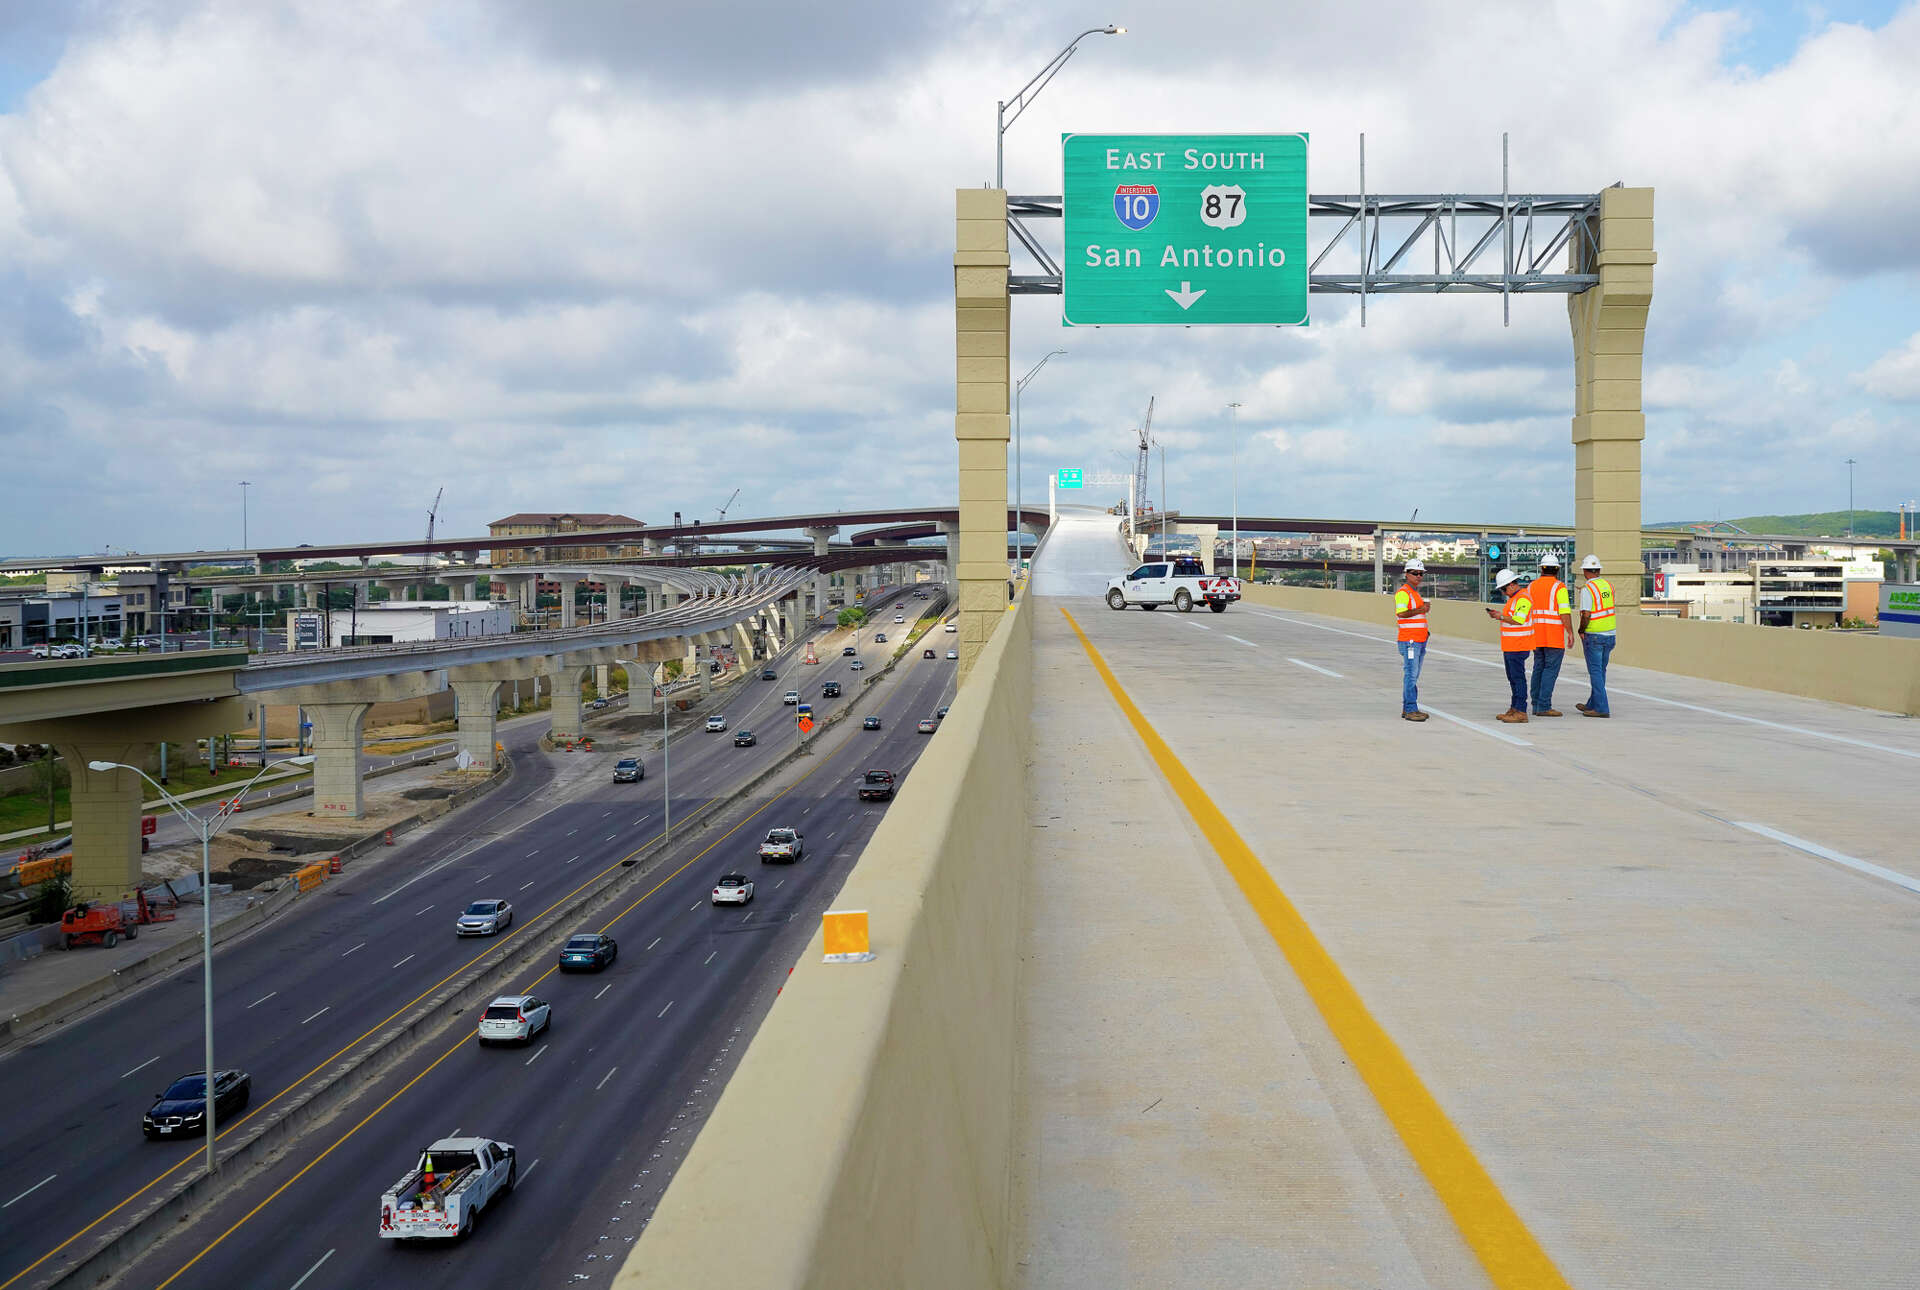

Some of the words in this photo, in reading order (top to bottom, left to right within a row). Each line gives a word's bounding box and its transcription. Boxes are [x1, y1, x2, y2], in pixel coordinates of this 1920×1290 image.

[1123, 196, 1150, 220] 10
[1205, 194, 1242, 219] 87
[1086, 244, 1141, 267] San
[1160, 243, 1286, 267] Antonio
[1511, 548, 1565, 556] CARVANA
